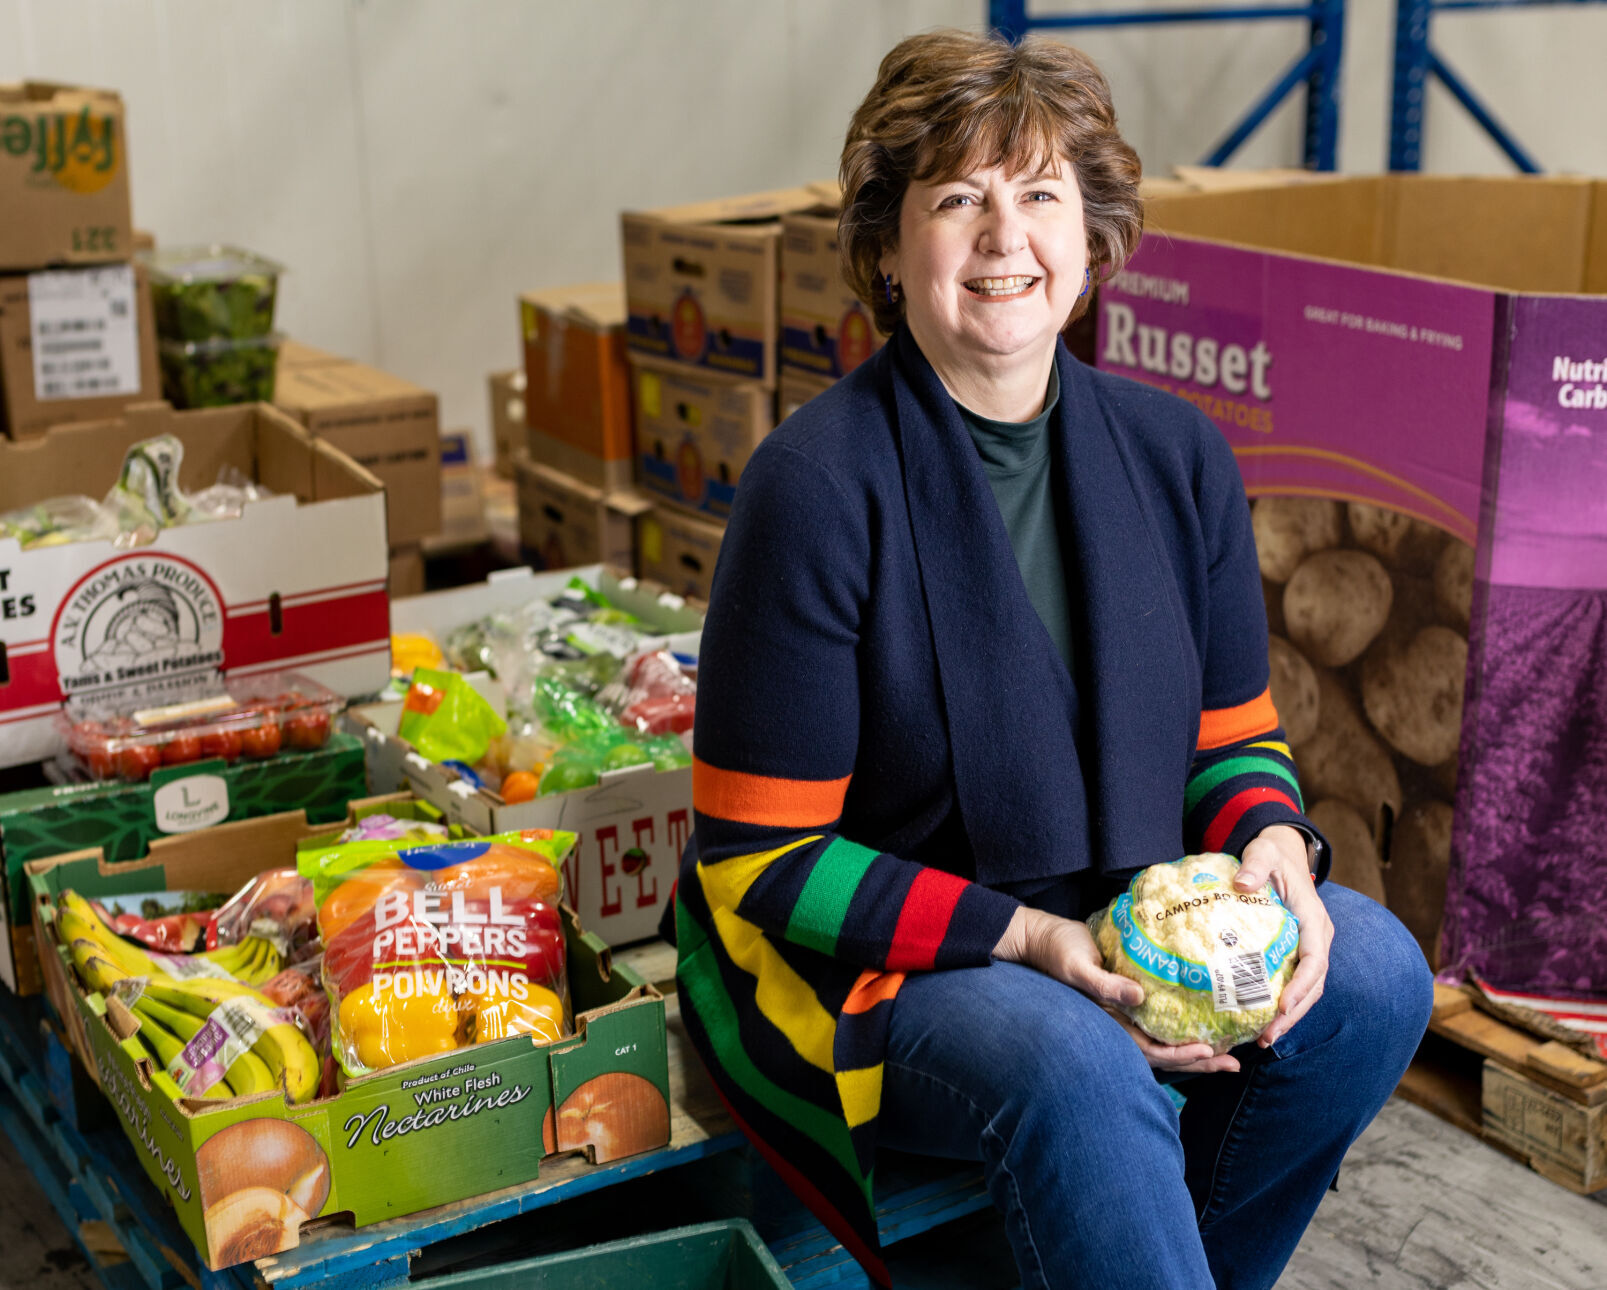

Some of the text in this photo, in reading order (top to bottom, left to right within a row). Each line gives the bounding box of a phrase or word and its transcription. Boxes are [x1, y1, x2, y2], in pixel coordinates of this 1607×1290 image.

[1106, 271, 1190, 305] PREMIUM
[1304, 305, 1463, 351] GREAT FOR BAKING & FRYING
[1104, 302, 1272, 400] Russet
[1558, 383, 1607, 409] Carb
[3, 595, 36, 619] ES
[74, 563, 147, 615] THOMAS
[152, 563, 218, 626] PRODUCE
[63, 673, 100, 690] Yams
[117, 661, 160, 679] Sweet
[163, 651, 222, 671] Potatoes
[181, 785, 201, 807] L
[374, 886, 526, 933] BELL
[1155, 896, 1209, 921] CAMPOS
[1213, 892, 1272, 907] BOQUEZ
[373, 926, 527, 958] PEPPERS
[1129, 936, 1203, 984] ORGANIC
[372, 969, 530, 1001] POIVRONS
[615, 1044, 630, 1056] CAT
[402, 1064, 476, 1090] Product of Chile
[414, 1072, 501, 1107] White Flesh
[344, 1084, 532, 1149] Nectarines
